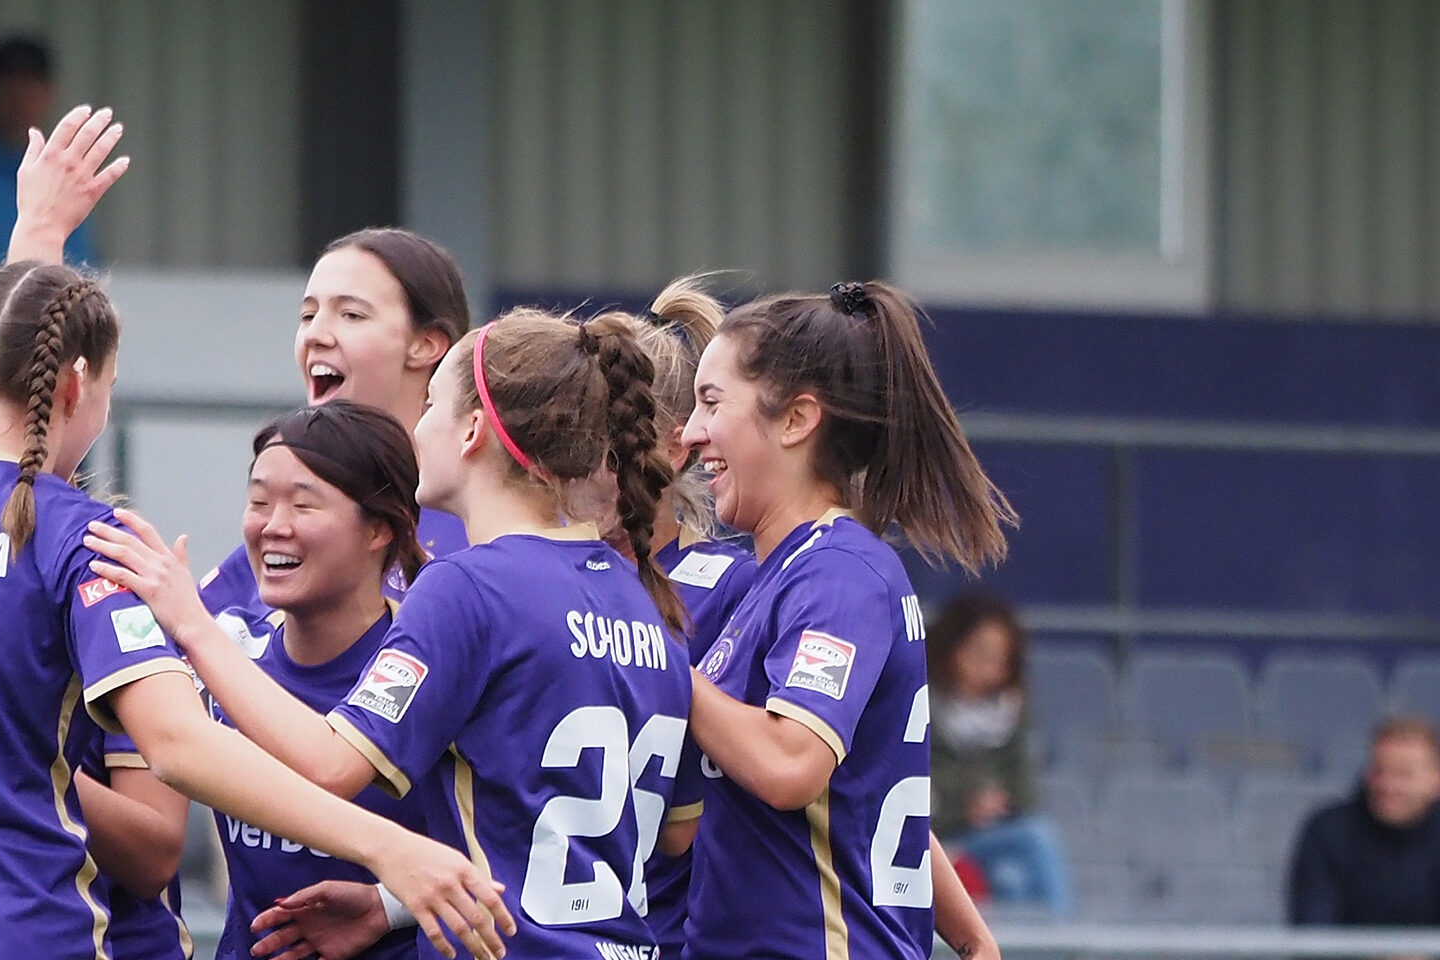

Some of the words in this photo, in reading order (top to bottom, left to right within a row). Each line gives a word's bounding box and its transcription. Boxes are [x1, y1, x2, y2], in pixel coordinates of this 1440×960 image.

[565, 610, 667, 670] SCHORN
[520, 705, 688, 924] 26
[571, 898, 590, 912] 1911
